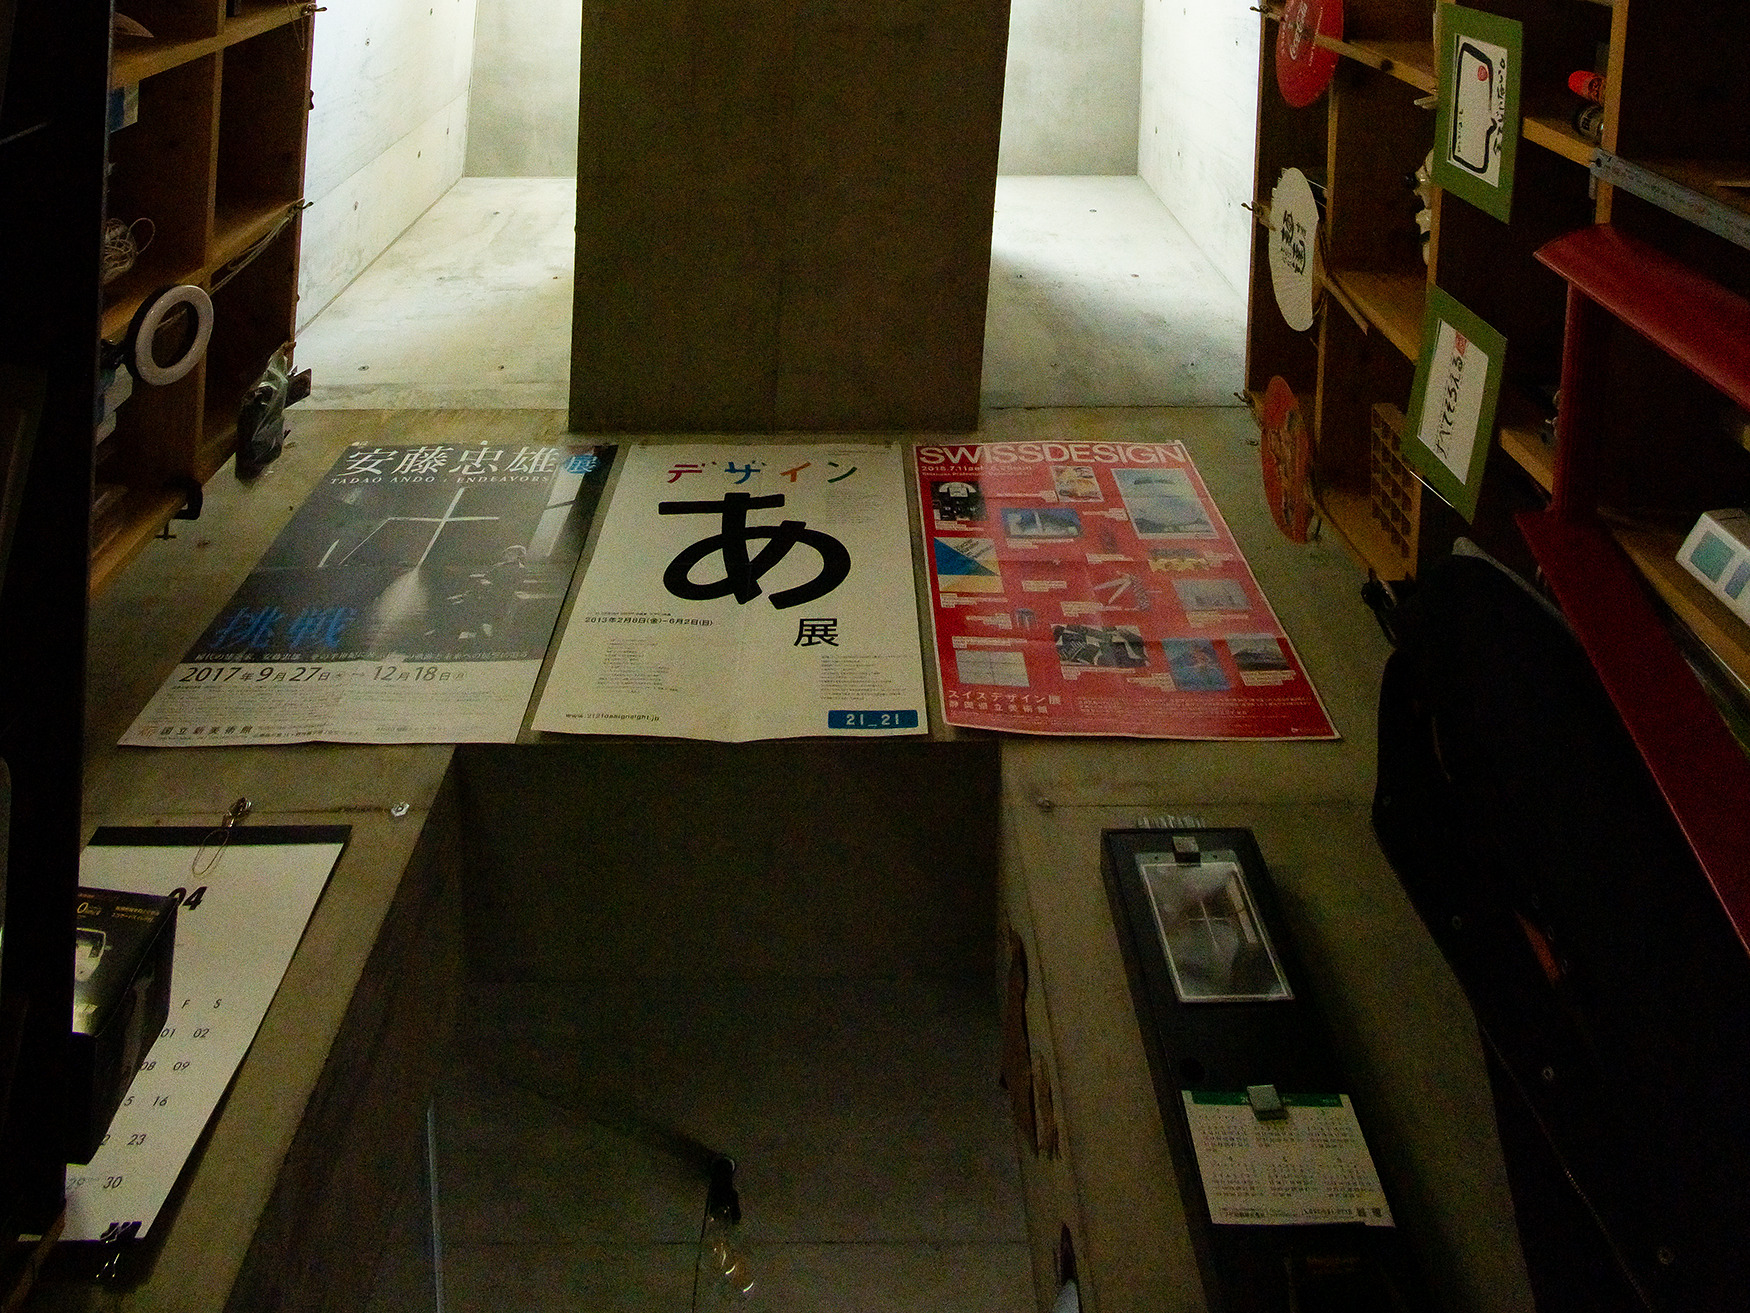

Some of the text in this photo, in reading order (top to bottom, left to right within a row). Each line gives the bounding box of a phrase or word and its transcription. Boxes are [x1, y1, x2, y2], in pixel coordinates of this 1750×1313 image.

[918, 444, 1186, 465] SWISSDESIGN
[667, 460, 858, 485] デザイン
[330, 476, 550, 484] TADAO ANDO ENDEAVORS
[657, 492, 852, 610] あ
[794, 616, 840, 647] 展
[948, 690, 1061, 706] スイスデザイン展
[845, 712, 901, 727] 21_21
[168, 887, 207, 911] 04
[181, 998, 222, 1009] F S
[161, 1028, 209, 1038] 01 02
[139, 1061, 190, 1071] 08 09
[152, 1095, 169, 1107] 16
[127, 1133, 147, 1146] 23
[103, 1176, 123, 1189] 30
